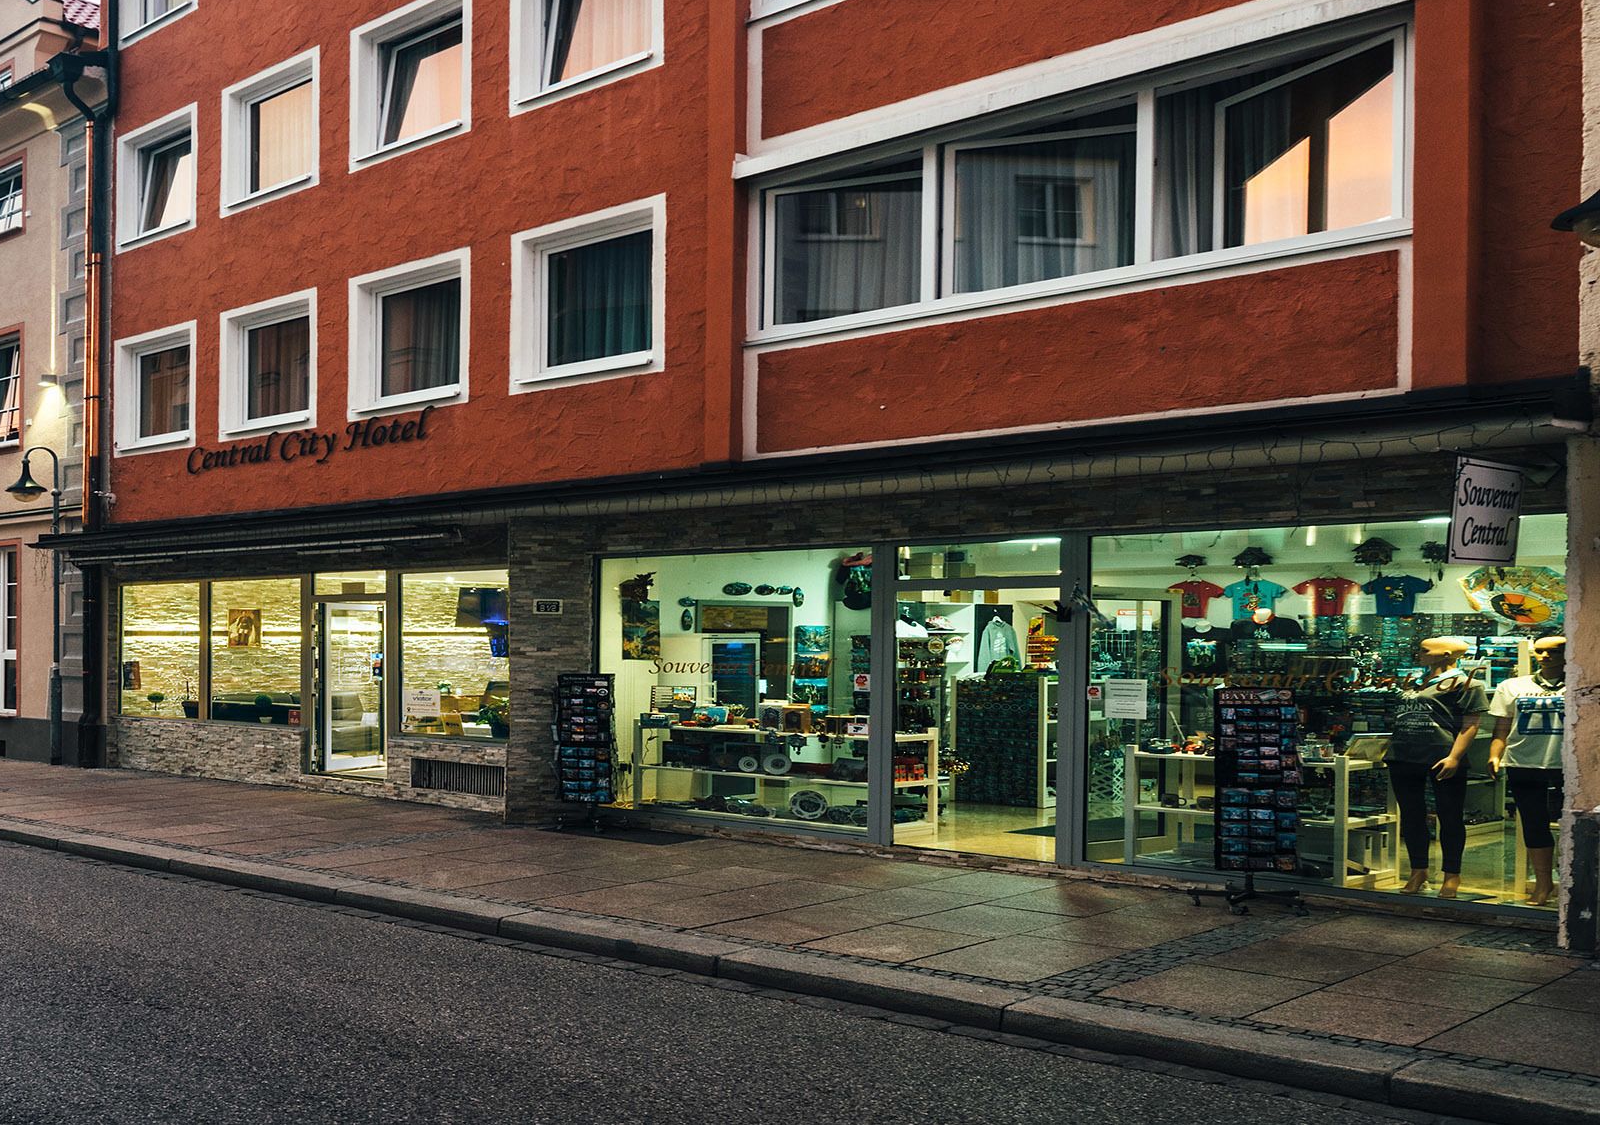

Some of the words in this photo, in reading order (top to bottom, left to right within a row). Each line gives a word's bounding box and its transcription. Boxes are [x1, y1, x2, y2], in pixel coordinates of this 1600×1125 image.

[186, 431, 279, 475] Central
[280, 428, 336, 464] City
[344, 404, 436, 452] Hotel
[1459, 477, 1520, 510] Souvenir
[1461, 516, 1514, 547] Central
[1152, 666, 1313, 691] Souvenir
